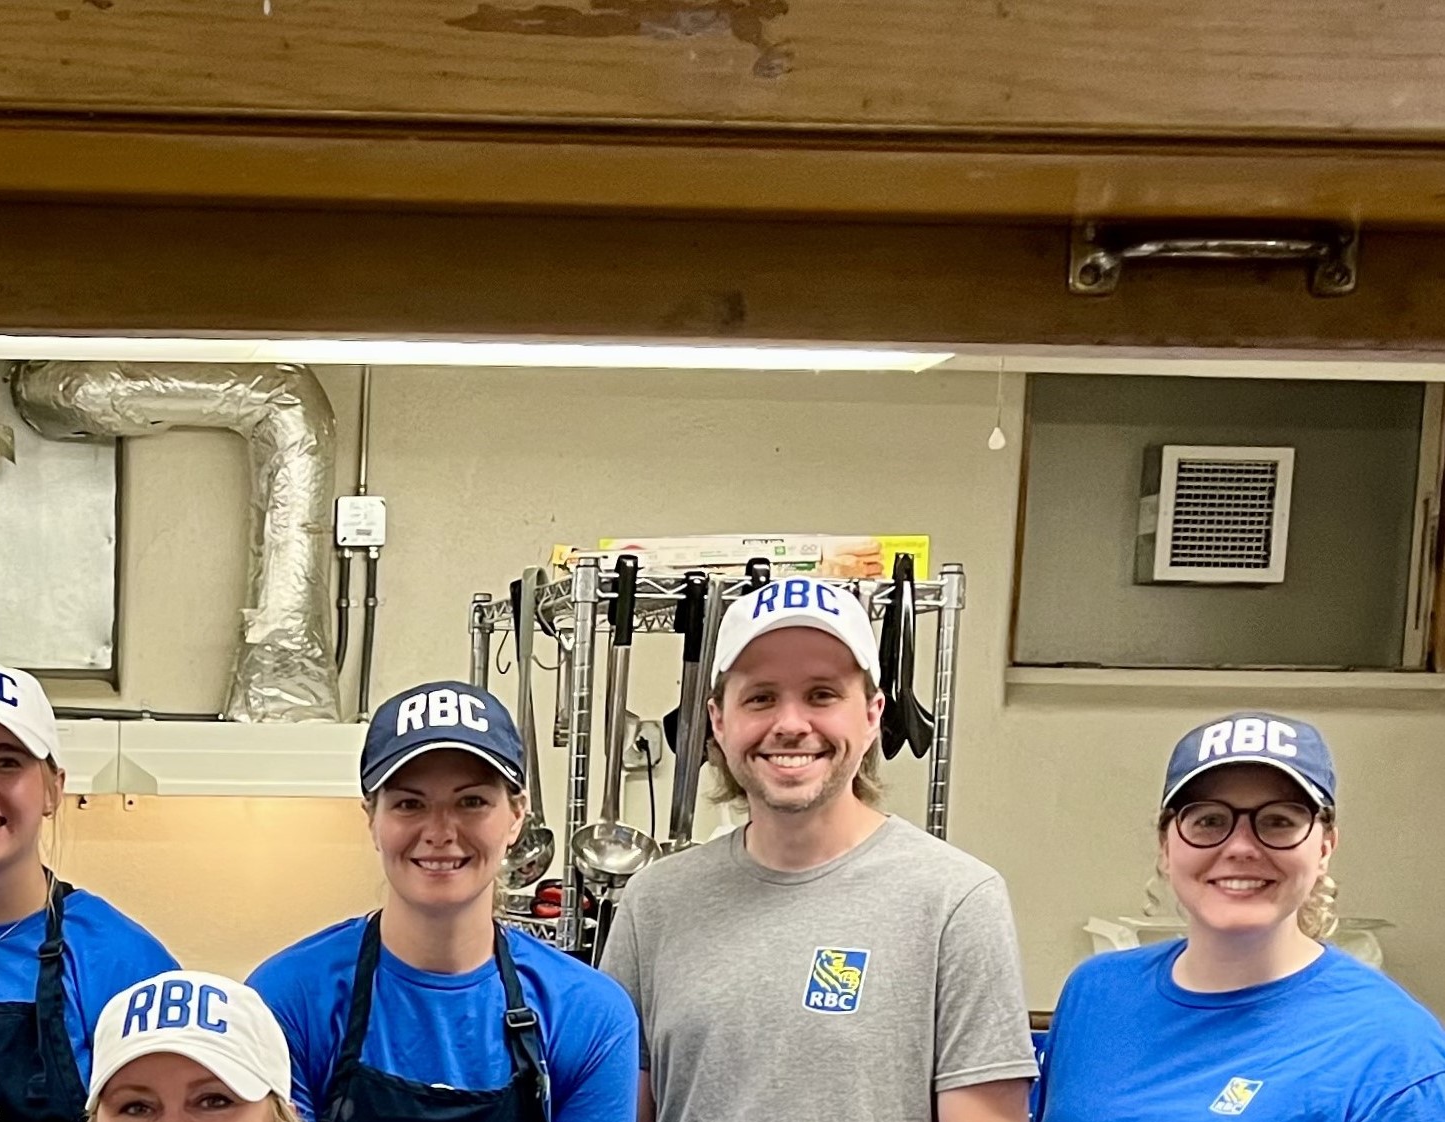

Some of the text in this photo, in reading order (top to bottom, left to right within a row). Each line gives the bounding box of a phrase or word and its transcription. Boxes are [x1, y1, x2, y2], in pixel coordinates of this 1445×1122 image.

[752, 579, 840, 620] RBC
[397, 688, 488, 736] RBC
[1198, 718, 1297, 761] RBC
[122, 979, 227, 1038] RBC
[809, 991, 854, 1010] RBC
